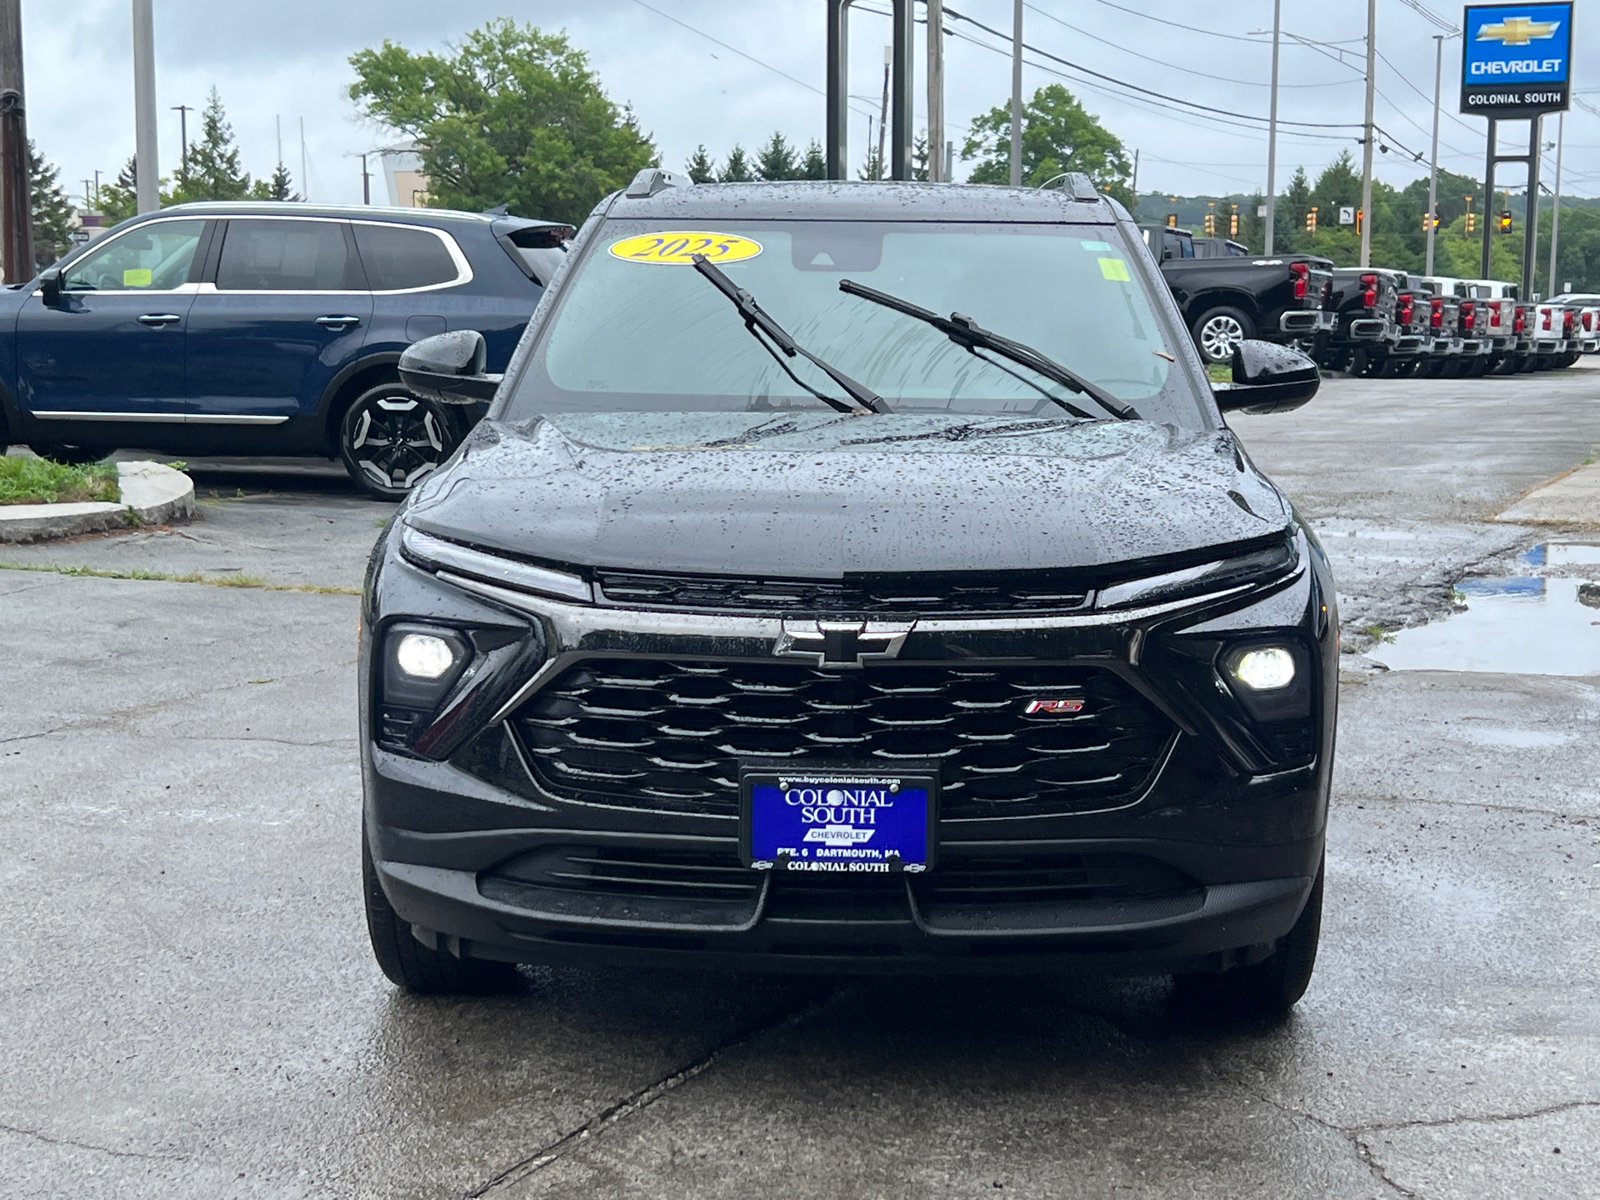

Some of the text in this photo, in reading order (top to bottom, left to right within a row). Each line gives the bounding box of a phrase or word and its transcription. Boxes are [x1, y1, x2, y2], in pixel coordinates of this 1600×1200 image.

[1471, 59, 1562, 74] CHEVROLET
[1468, 92, 1561, 105] COLONIAL SOUTH
[629, 238, 740, 258] 2025
[1025, 699, 1085, 714] RS
[778, 776, 901, 785] www.buycolonialsouth.com
[785, 789, 893, 808] COLONIAL
[801, 807, 877, 824] SOUTH
[811, 831, 868, 840] CHEVROLET
[801, 847, 809, 857] 6
[816, 848, 882, 859] DARTMOUTH,
[787, 861, 890, 873] COLONIAL SOUTH
